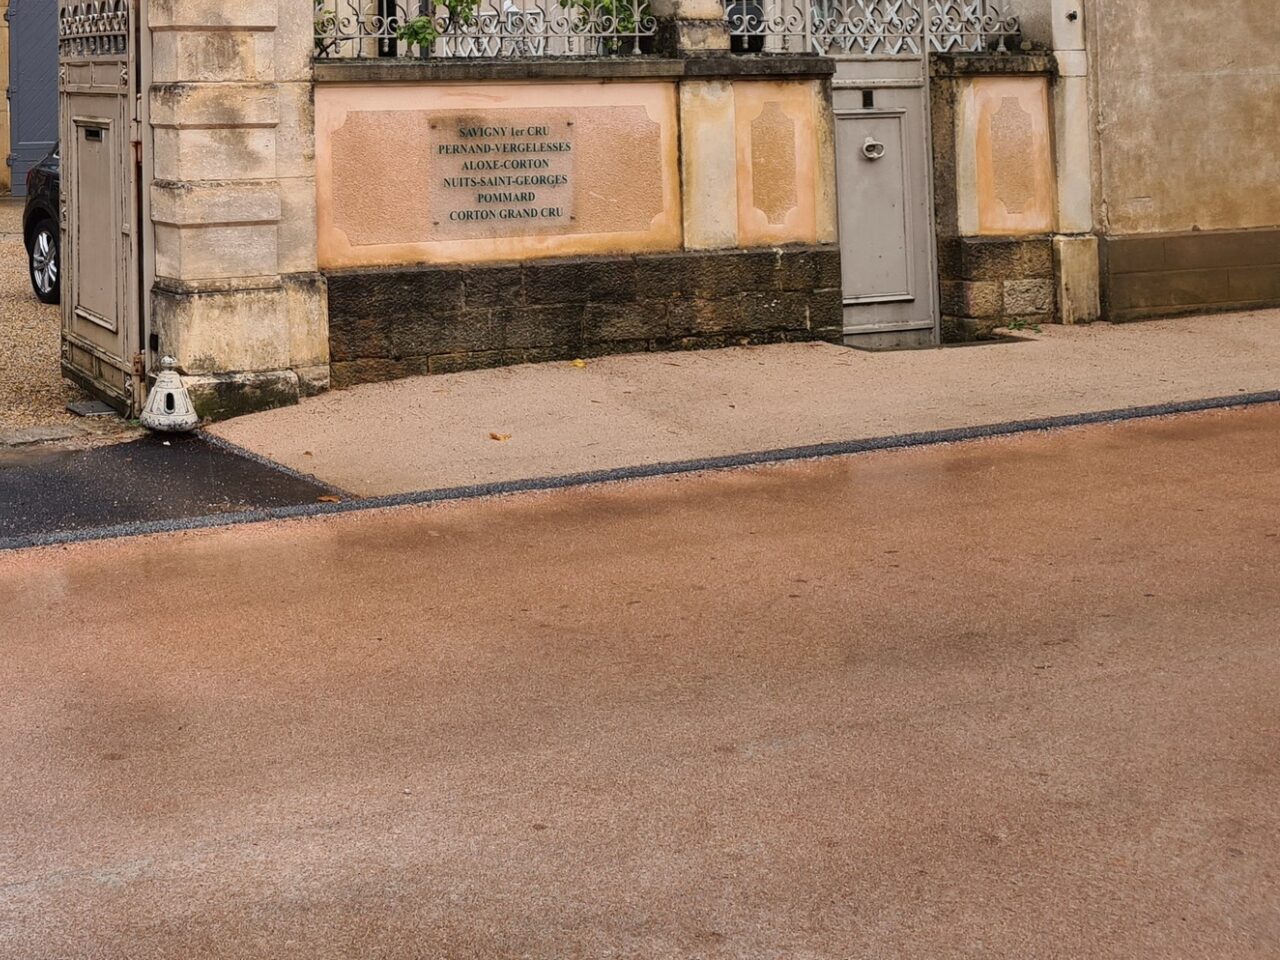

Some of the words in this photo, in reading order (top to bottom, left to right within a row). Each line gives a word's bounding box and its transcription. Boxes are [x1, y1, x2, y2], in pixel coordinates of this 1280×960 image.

[459, 127, 507, 138] SAVIGNY
[511, 127, 525, 137] 1er
[527, 126, 550, 136] CRU
[438, 142, 572, 154] PERNAND-VERGELESSES
[461, 158, 550, 171] ALOXE-CORTON
[443, 174, 568, 188] NUITS-SAINT-GEORGES
[478, 192, 536, 203] POMMARD
[449, 210, 496, 221] CORTON
[499, 208, 538, 220] GRAND
[540, 207, 564, 218] CRU
